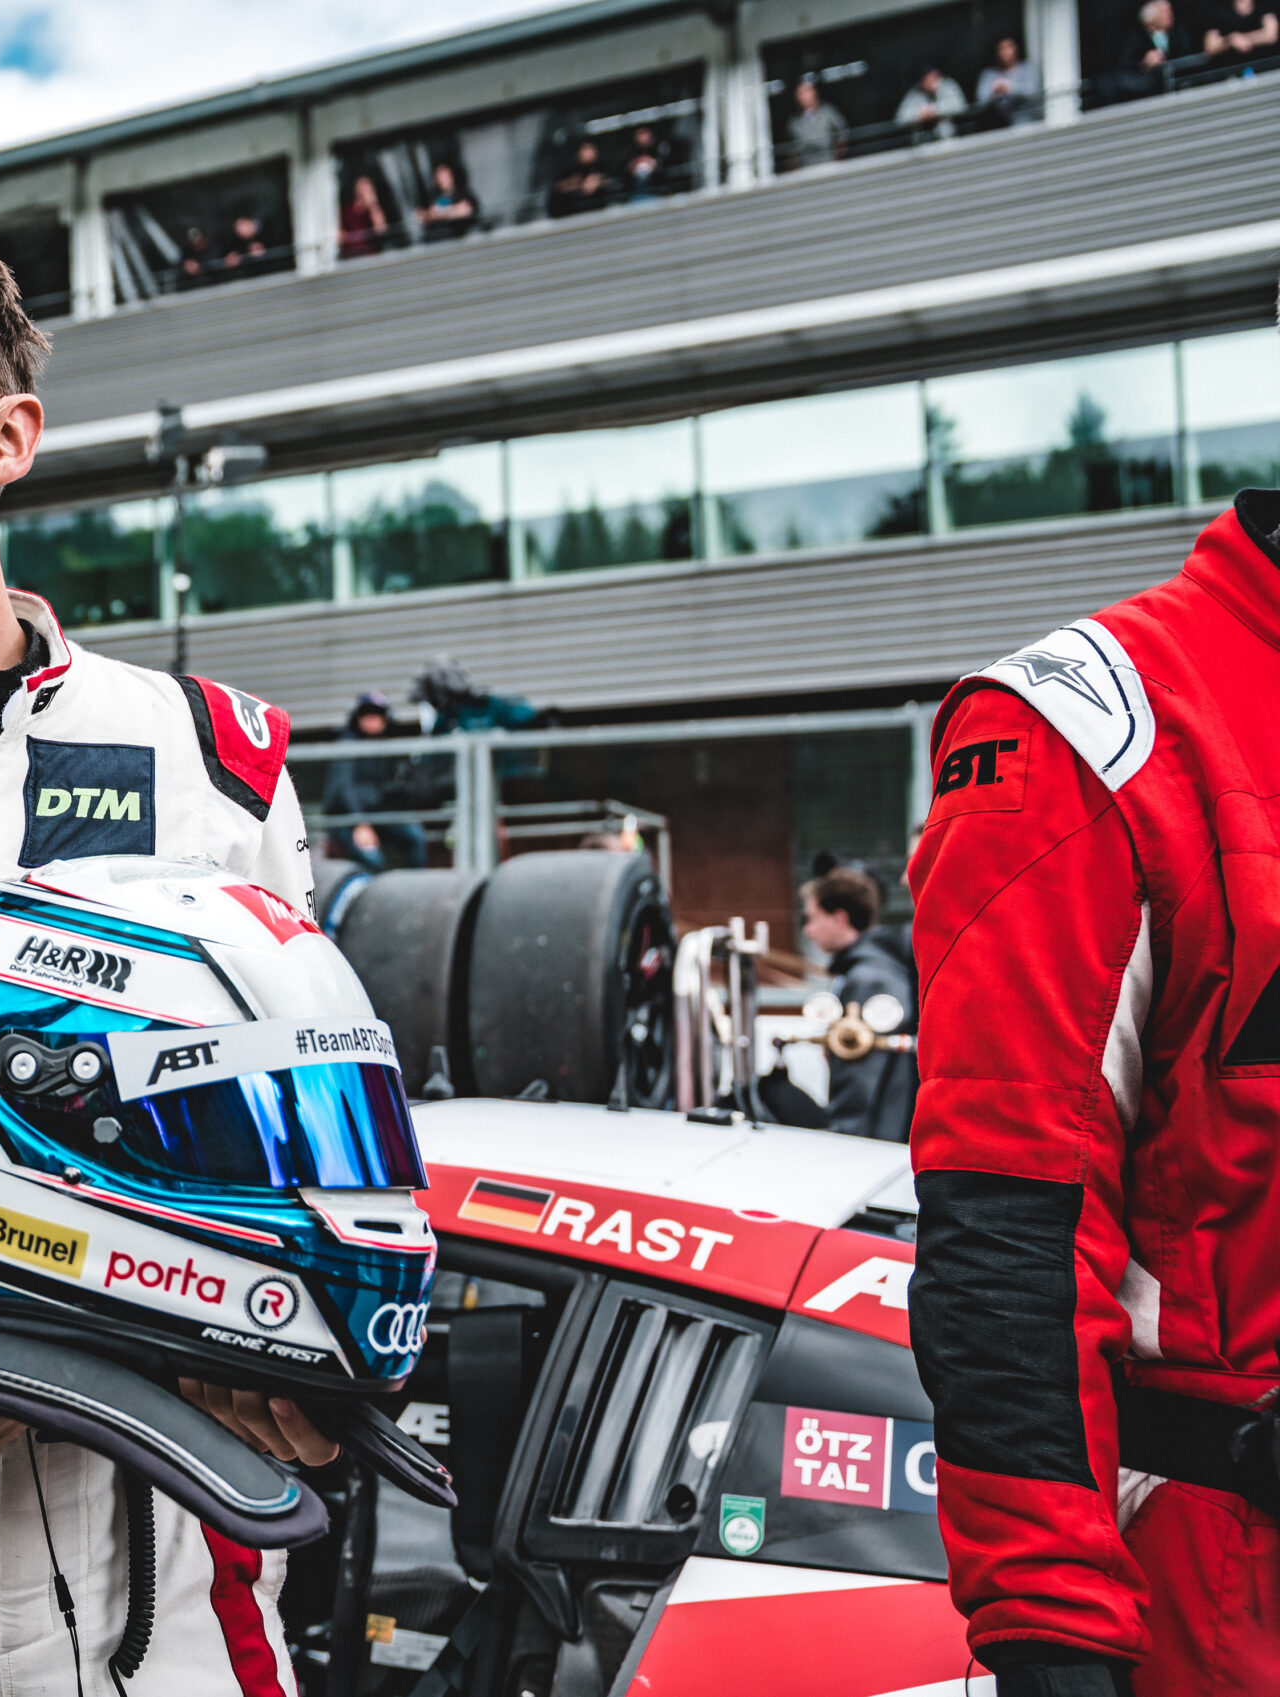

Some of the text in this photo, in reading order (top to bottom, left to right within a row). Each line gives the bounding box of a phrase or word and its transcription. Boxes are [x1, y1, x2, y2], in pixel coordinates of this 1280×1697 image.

[36, 788, 141, 821] DTM
[146, 1040, 220, 1086] ABT
[542, 1197, 734, 1272] RAST
[104, 1251, 226, 1304] porta
[795, 1417, 873, 1462] ÖTZ
[793, 1457, 870, 1493] TAL
